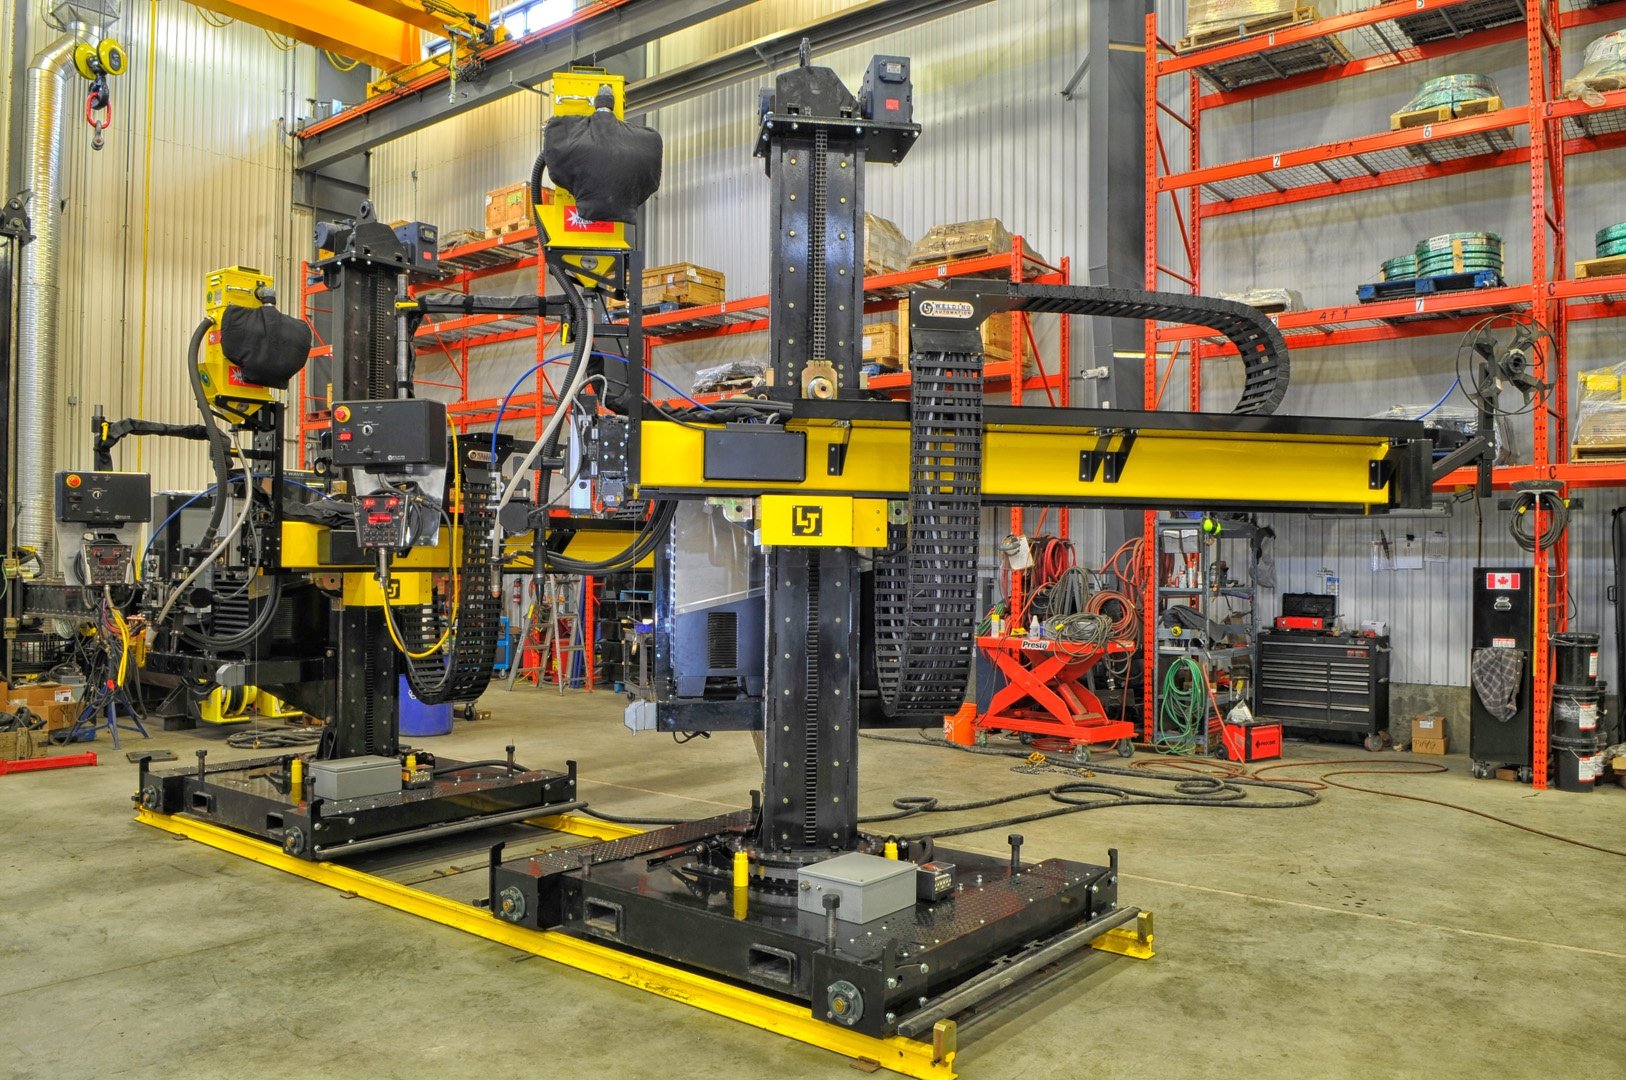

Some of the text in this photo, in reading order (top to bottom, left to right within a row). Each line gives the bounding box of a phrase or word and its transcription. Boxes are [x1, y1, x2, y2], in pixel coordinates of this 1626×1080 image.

[1546, 102, 1554, 116] C
[1425, 126, 1430, 137] 6
[1274, 155, 1280, 166] 2
[939, 266, 946, 275] 10
[1548, 282, 1555, 296] C
[1417, 299, 1423, 311] 7
[1549, 465, 1556, 479] C
[796, 507, 819, 534] LJ
[1022, 640, 1048, 649] Presto
